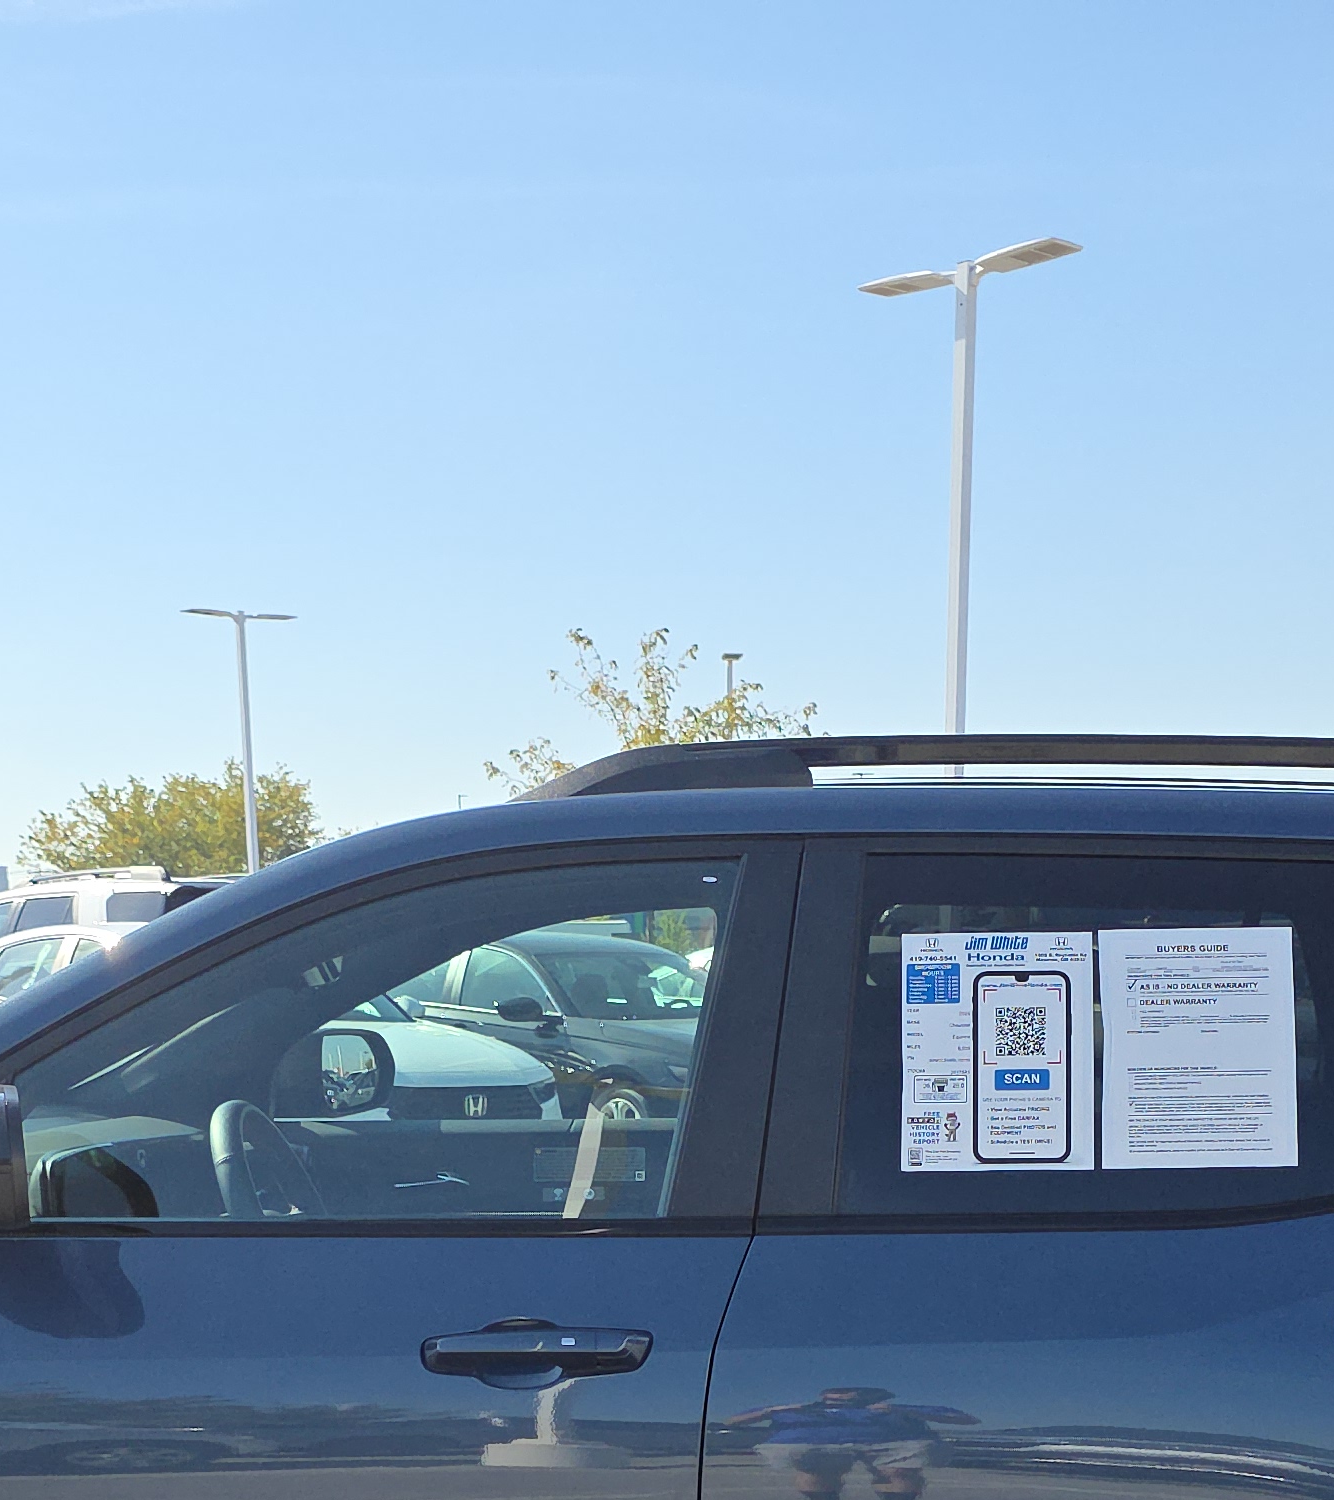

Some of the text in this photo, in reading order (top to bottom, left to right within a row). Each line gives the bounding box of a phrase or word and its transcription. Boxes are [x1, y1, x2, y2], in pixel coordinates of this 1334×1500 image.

[965, 936, 1029, 950] Jim White
[1156, 944, 1229, 953] BUYERS GUIDE
[967, 953, 1025, 962] Honda
[1139, 983, 1151, 991] AS
[1152, 983, 1160, 991] IS
[1180, 982, 1212, 990] DEALER
[1213, 981, 1258, 989] WARRANTY
[1139, 998, 1171, 1006] DEALER
[1003, 1073, 1040, 1084] SCAN
